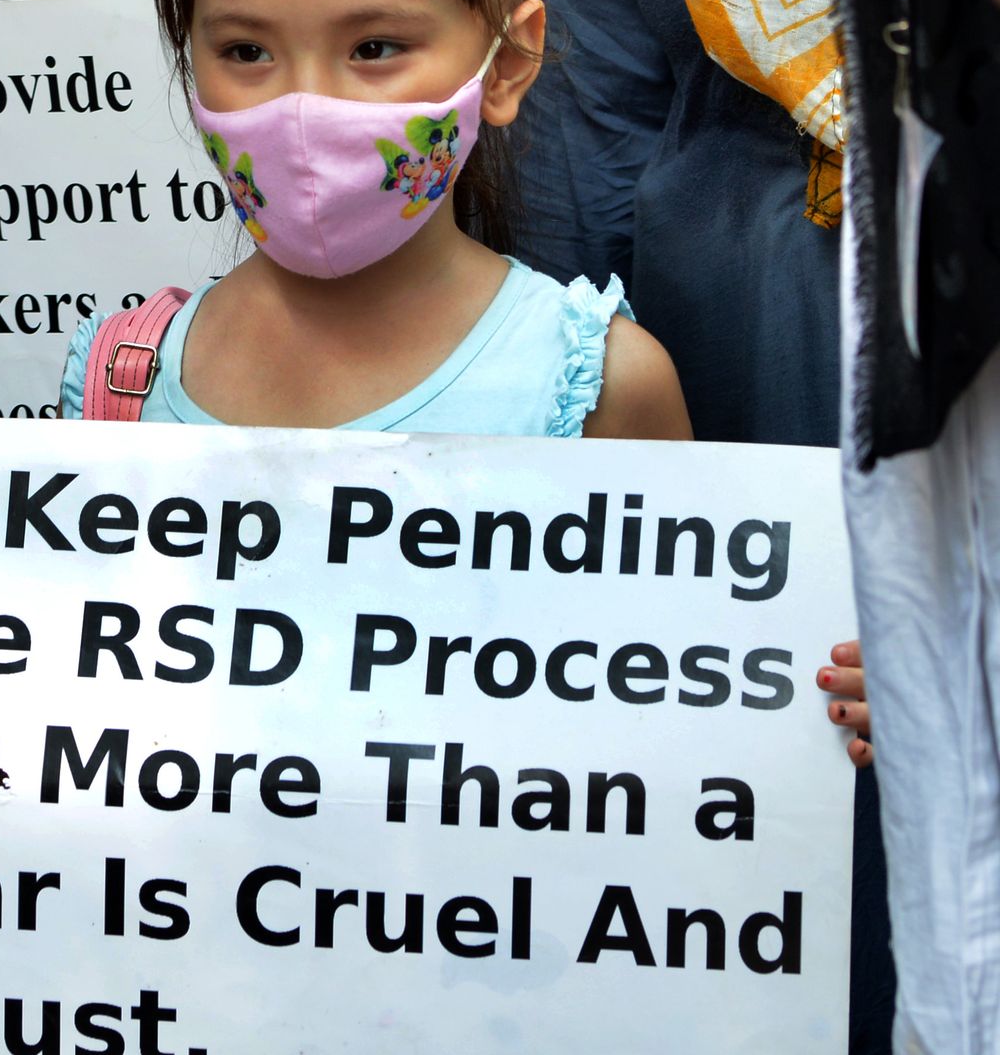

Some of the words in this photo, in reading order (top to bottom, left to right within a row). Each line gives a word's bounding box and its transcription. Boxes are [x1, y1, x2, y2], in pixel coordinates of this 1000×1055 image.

[171, 170, 225, 222] to
[5, 471, 281, 580] Keep
[327, 487, 790, 601] Pending
[78, 601, 303, 686] RSD
[351, 614, 793, 709] Process
[40, 726, 320, 818] More
[365, 742, 646, 835] Than
[695, 778, 754, 841] a
[105, 858, 190, 940] Is
[236, 865, 531, 960] Cruel
[577, 885, 802, 974] And
